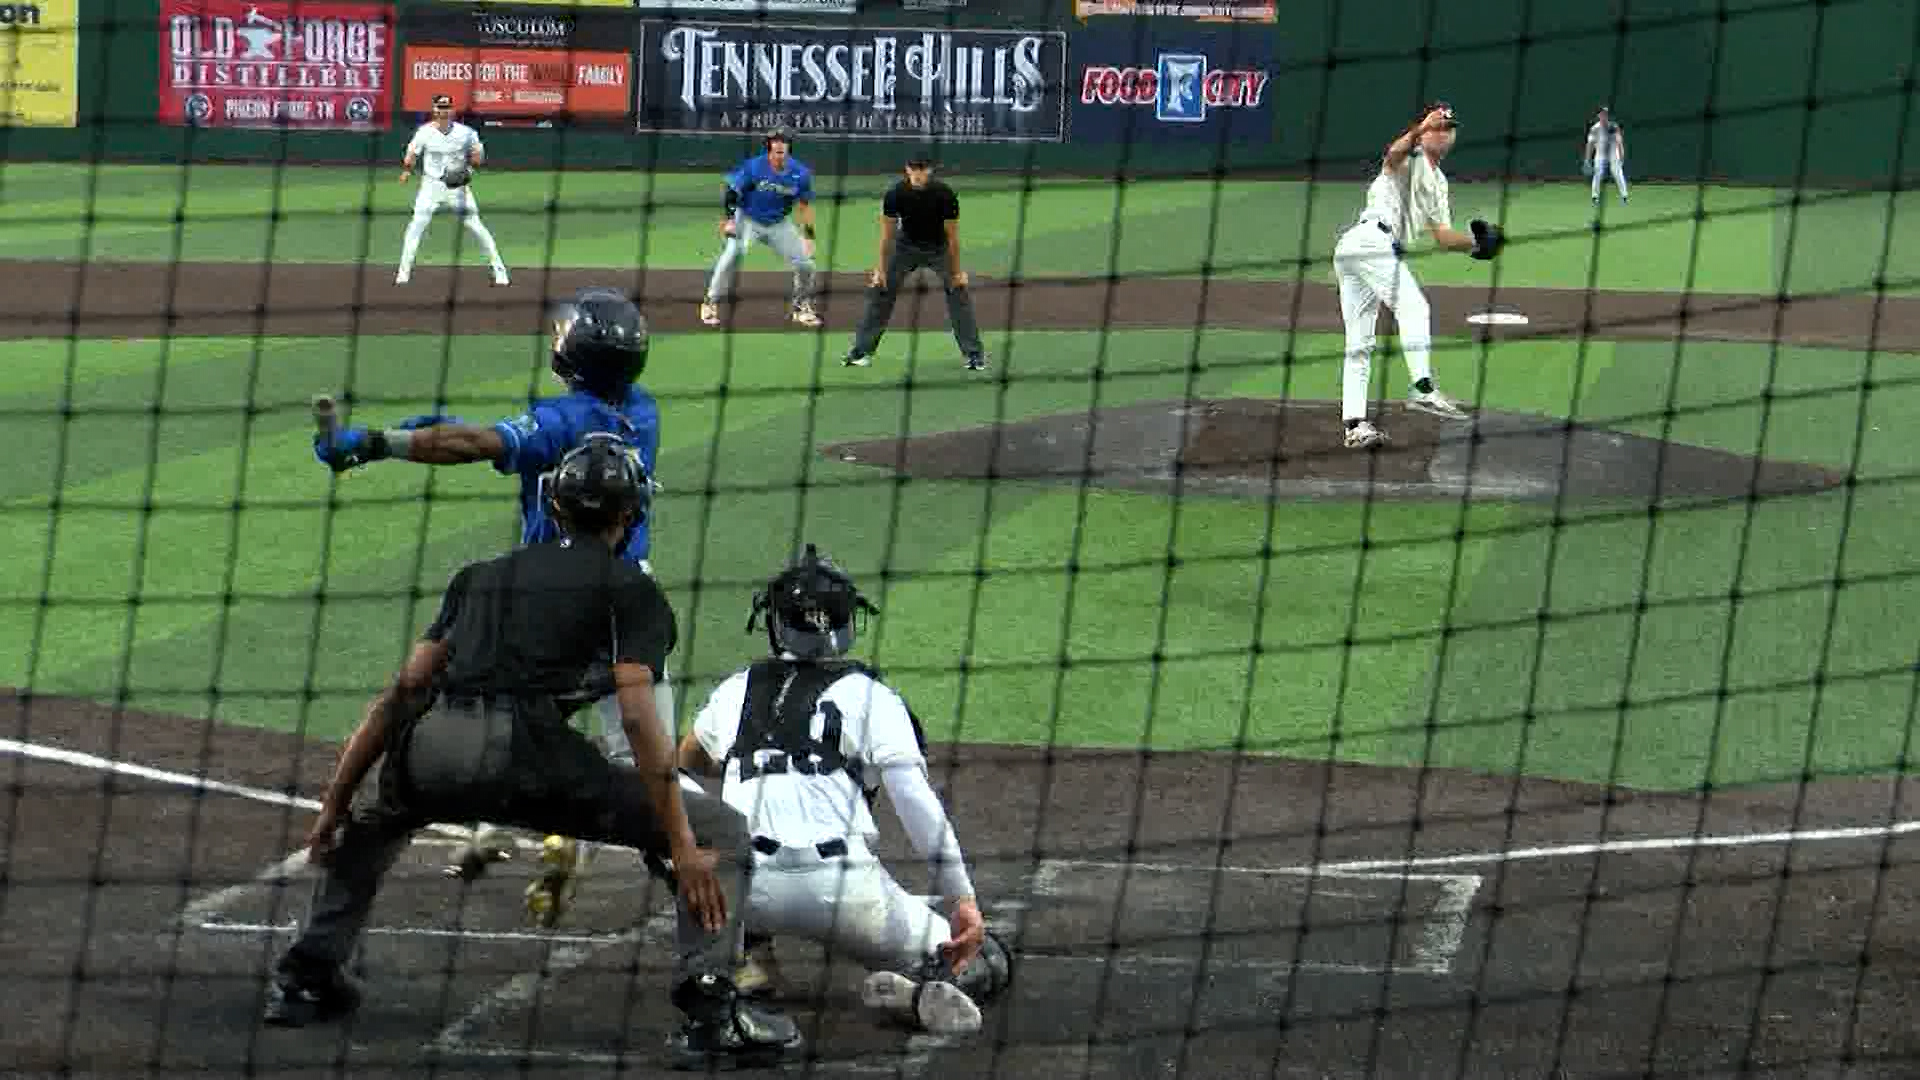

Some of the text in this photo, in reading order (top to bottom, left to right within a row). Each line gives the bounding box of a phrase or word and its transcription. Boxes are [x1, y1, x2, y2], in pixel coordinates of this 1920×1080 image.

[172, 15, 234, 59] OLD
[173, 63, 385, 87] DISTILLERY
[413, 62, 473, 81] DEGREES
[503, 63, 529, 83] THE
[577, 64, 624, 86] FAMILY
[662, 27, 1045, 112] TENNESSEE HILLS
[1080, 67, 1159, 105] FOOD
[1203, 69, 1270, 107] CITY
